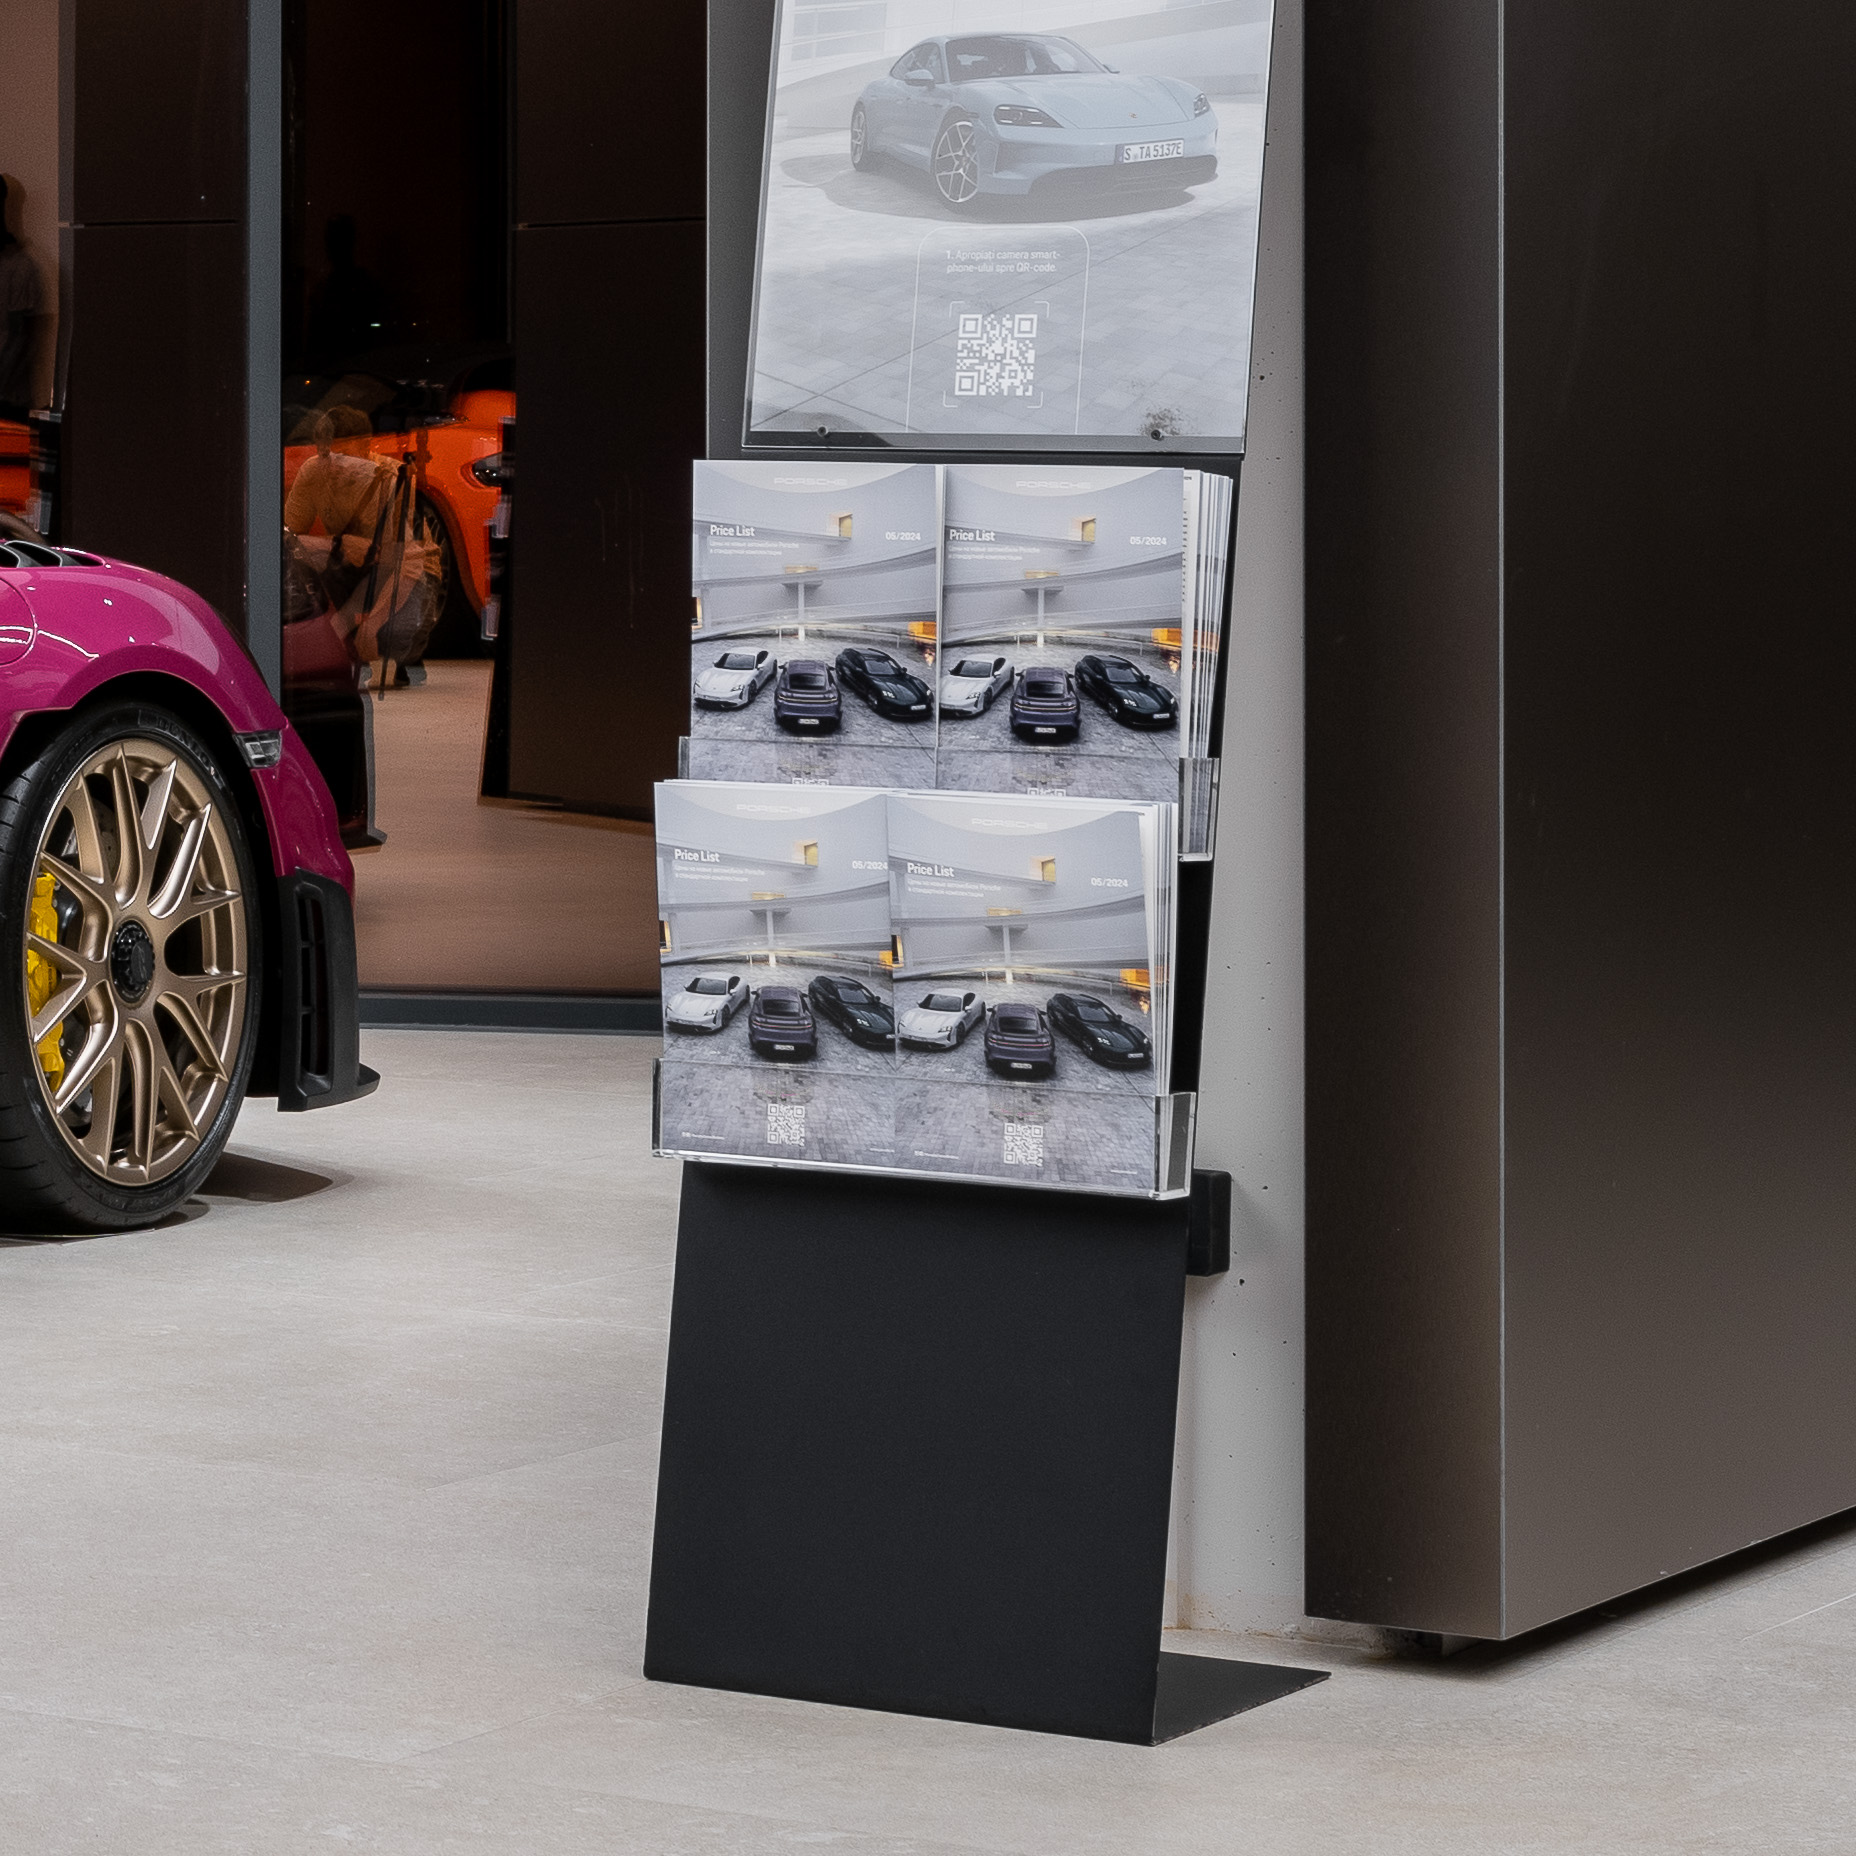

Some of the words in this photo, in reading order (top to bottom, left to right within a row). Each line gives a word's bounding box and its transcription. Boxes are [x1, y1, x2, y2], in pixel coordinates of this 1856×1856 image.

[996, 250, 1029, 260] camera
[709, 524, 734, 537] Price
[736, 525, 755, 537] List
[949, 529, 974, 541] Price
[975, 530, 995, 542] List
[885, 531, 921, 542] 05/2024
[1129, 535, 1167, 546] 05/2024
[674, 848, 699, 861] Price
[700, 850, 720, 863] List
[852, 860, 888, 871] 05/2024
[907, 862, 933, 876] Price
[934, 864, 955, 877] List
[1091, 877, 1129, 888] 05/2024
